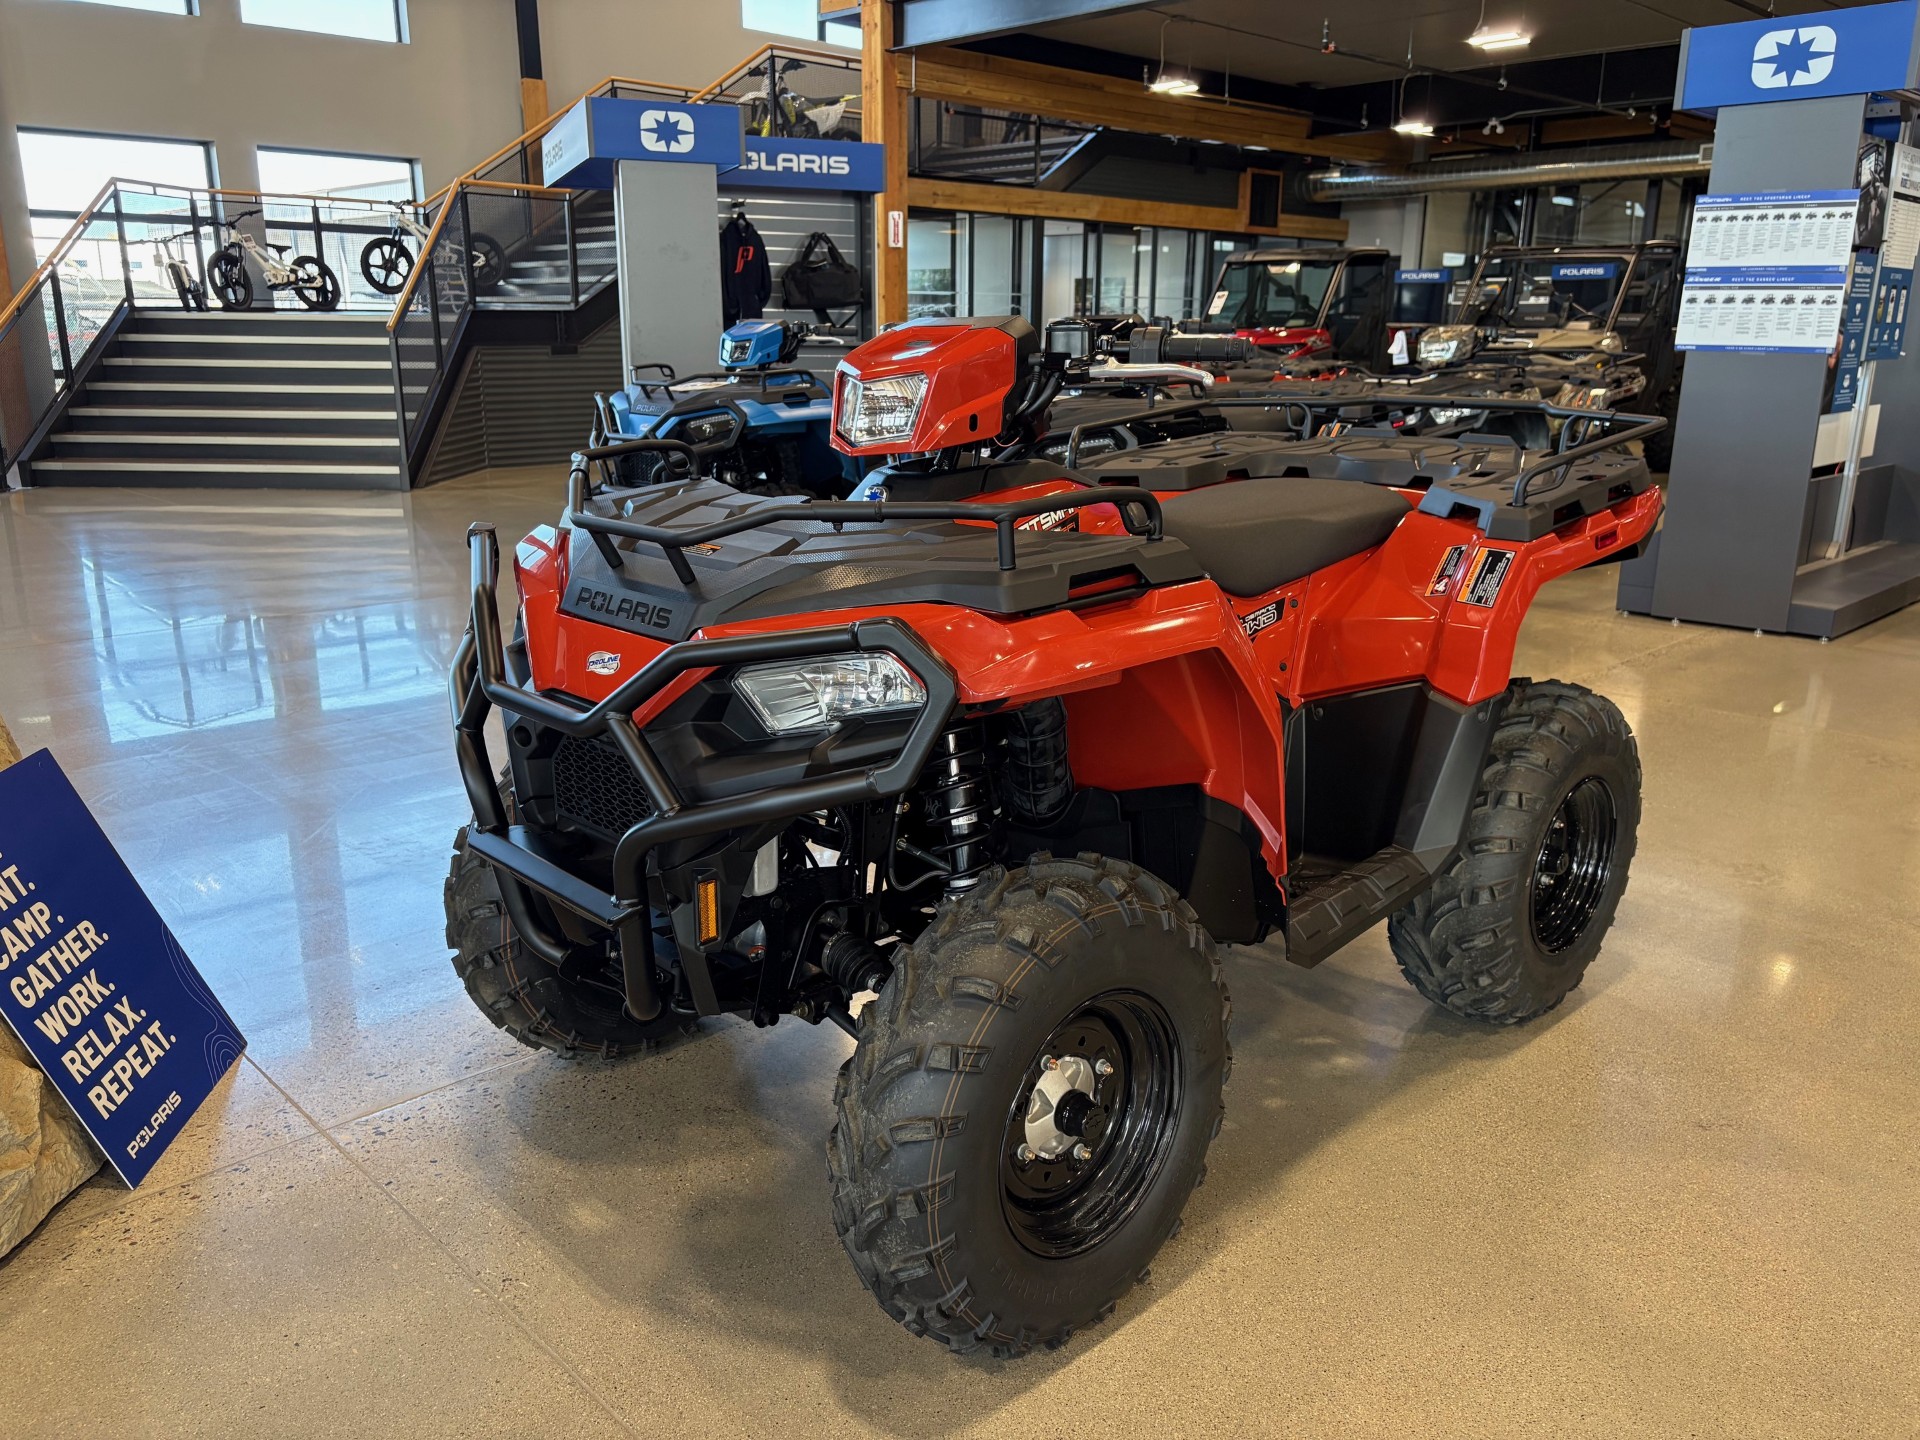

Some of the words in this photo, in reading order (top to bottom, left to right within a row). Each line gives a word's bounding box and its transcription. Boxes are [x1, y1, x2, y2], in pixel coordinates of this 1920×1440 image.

[739, 151, 850, 175] OLARIS
[1401, 271, 1440, 280] POLARIS
[1560, 267, 1604, 276] POLARIS
[576, 587, 673, 630] POLARIS
[10, 920, 109, 1009] GATHER.
[33, 968, 116, 1045] WORK.
[60, 995, 147, 1085] RELAX.
[87, 1020, 177, 1120] REPEAT.
[126, 1090, 182, 1159] POLARIS
